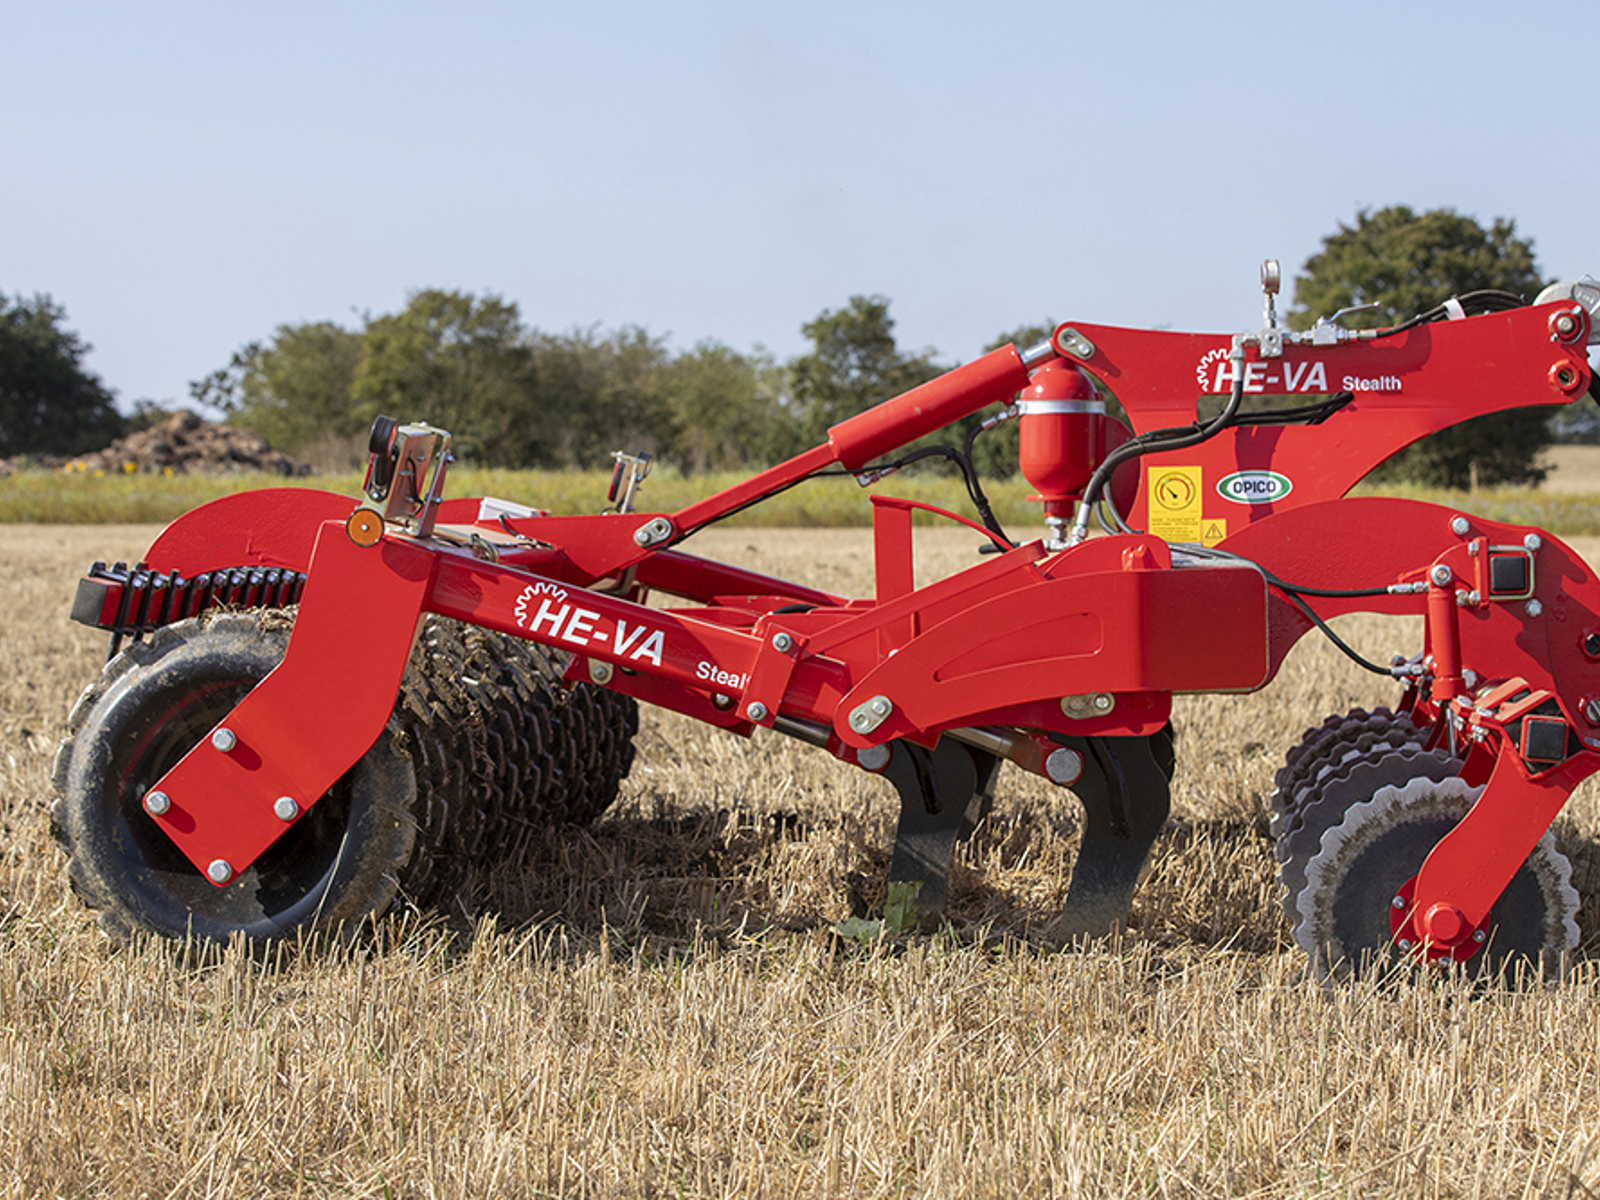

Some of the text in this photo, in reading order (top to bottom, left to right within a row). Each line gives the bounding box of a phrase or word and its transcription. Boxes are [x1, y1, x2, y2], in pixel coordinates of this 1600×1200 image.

[1213, 361, 1402, 393] HE-VA Stealth
[1233, 479, 1276, 494] OPICO
[529, 598, 751, 690] HE-VA Steal
